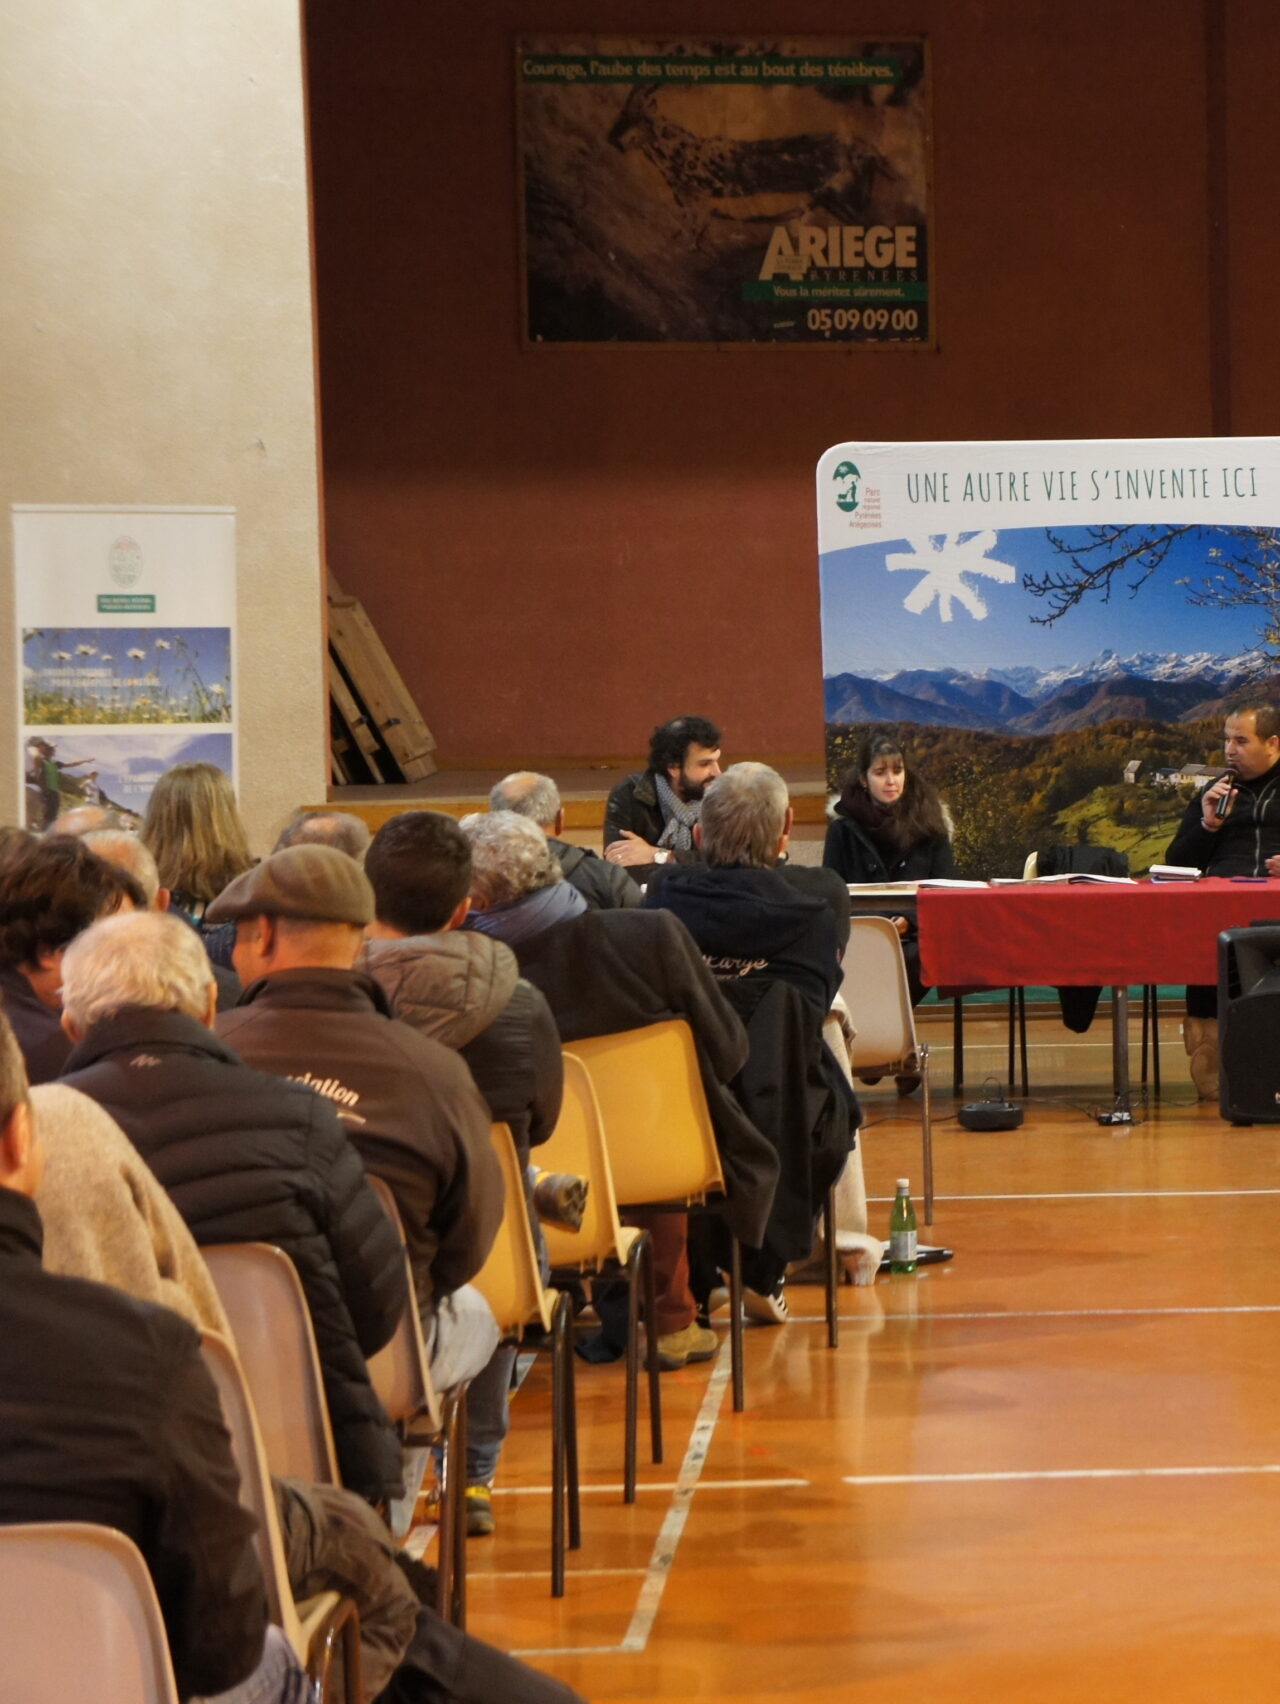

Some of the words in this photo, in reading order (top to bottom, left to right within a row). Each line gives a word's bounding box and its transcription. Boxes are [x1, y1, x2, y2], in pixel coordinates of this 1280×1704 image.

[523, 59, 588, 80] Courage,
[590, 60, 633, 76] l'aube
[636, 60, 661, 76] des
[664, 62, 710, 81] temps
[713, 63, 738, 77] est
[740, 65, 758, 77] au
[761, 61, 796, 77] bout
[800, 61, 824, 77] des
[827, 60, 894, 78] ténèbres.
[757, 225, 918, 281] ARIEGE
[773, 285, 798, 297] Vous
[799, 286, 809, 297] la
[907, 472, 951, 504] UNE
[962, 471, 1031, 503] AUTRE
[1042, 470, 1079, 502] VIE
[1090, 467, 1211, 501] S'INVENTE
[1221, 466, 1258, 499] ICI
